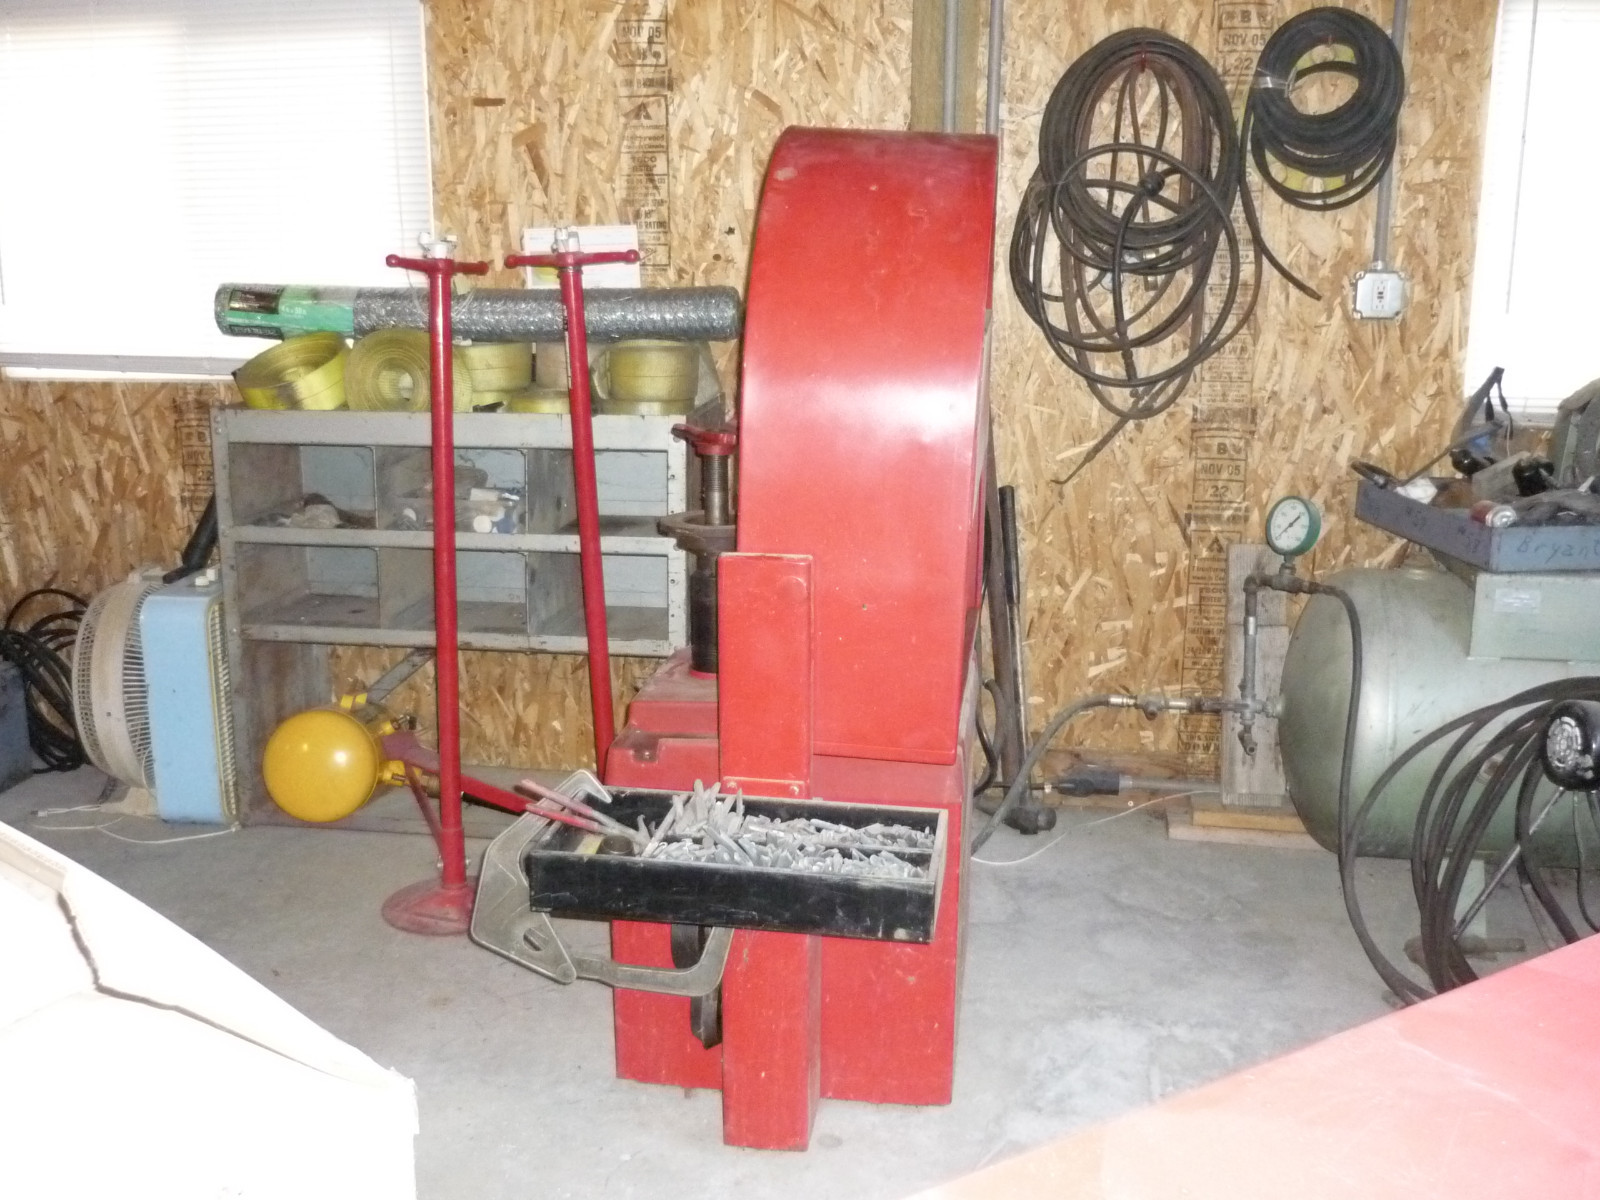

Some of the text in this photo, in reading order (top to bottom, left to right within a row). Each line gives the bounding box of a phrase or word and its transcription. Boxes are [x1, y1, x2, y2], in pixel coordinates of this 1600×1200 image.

[648, 26, 661, 38] 05
[1223, 34, 1267, 46] NOV 05
[1216, 442, 1227, 455] B
[1201, 464, 1241, 476] NOV 05
